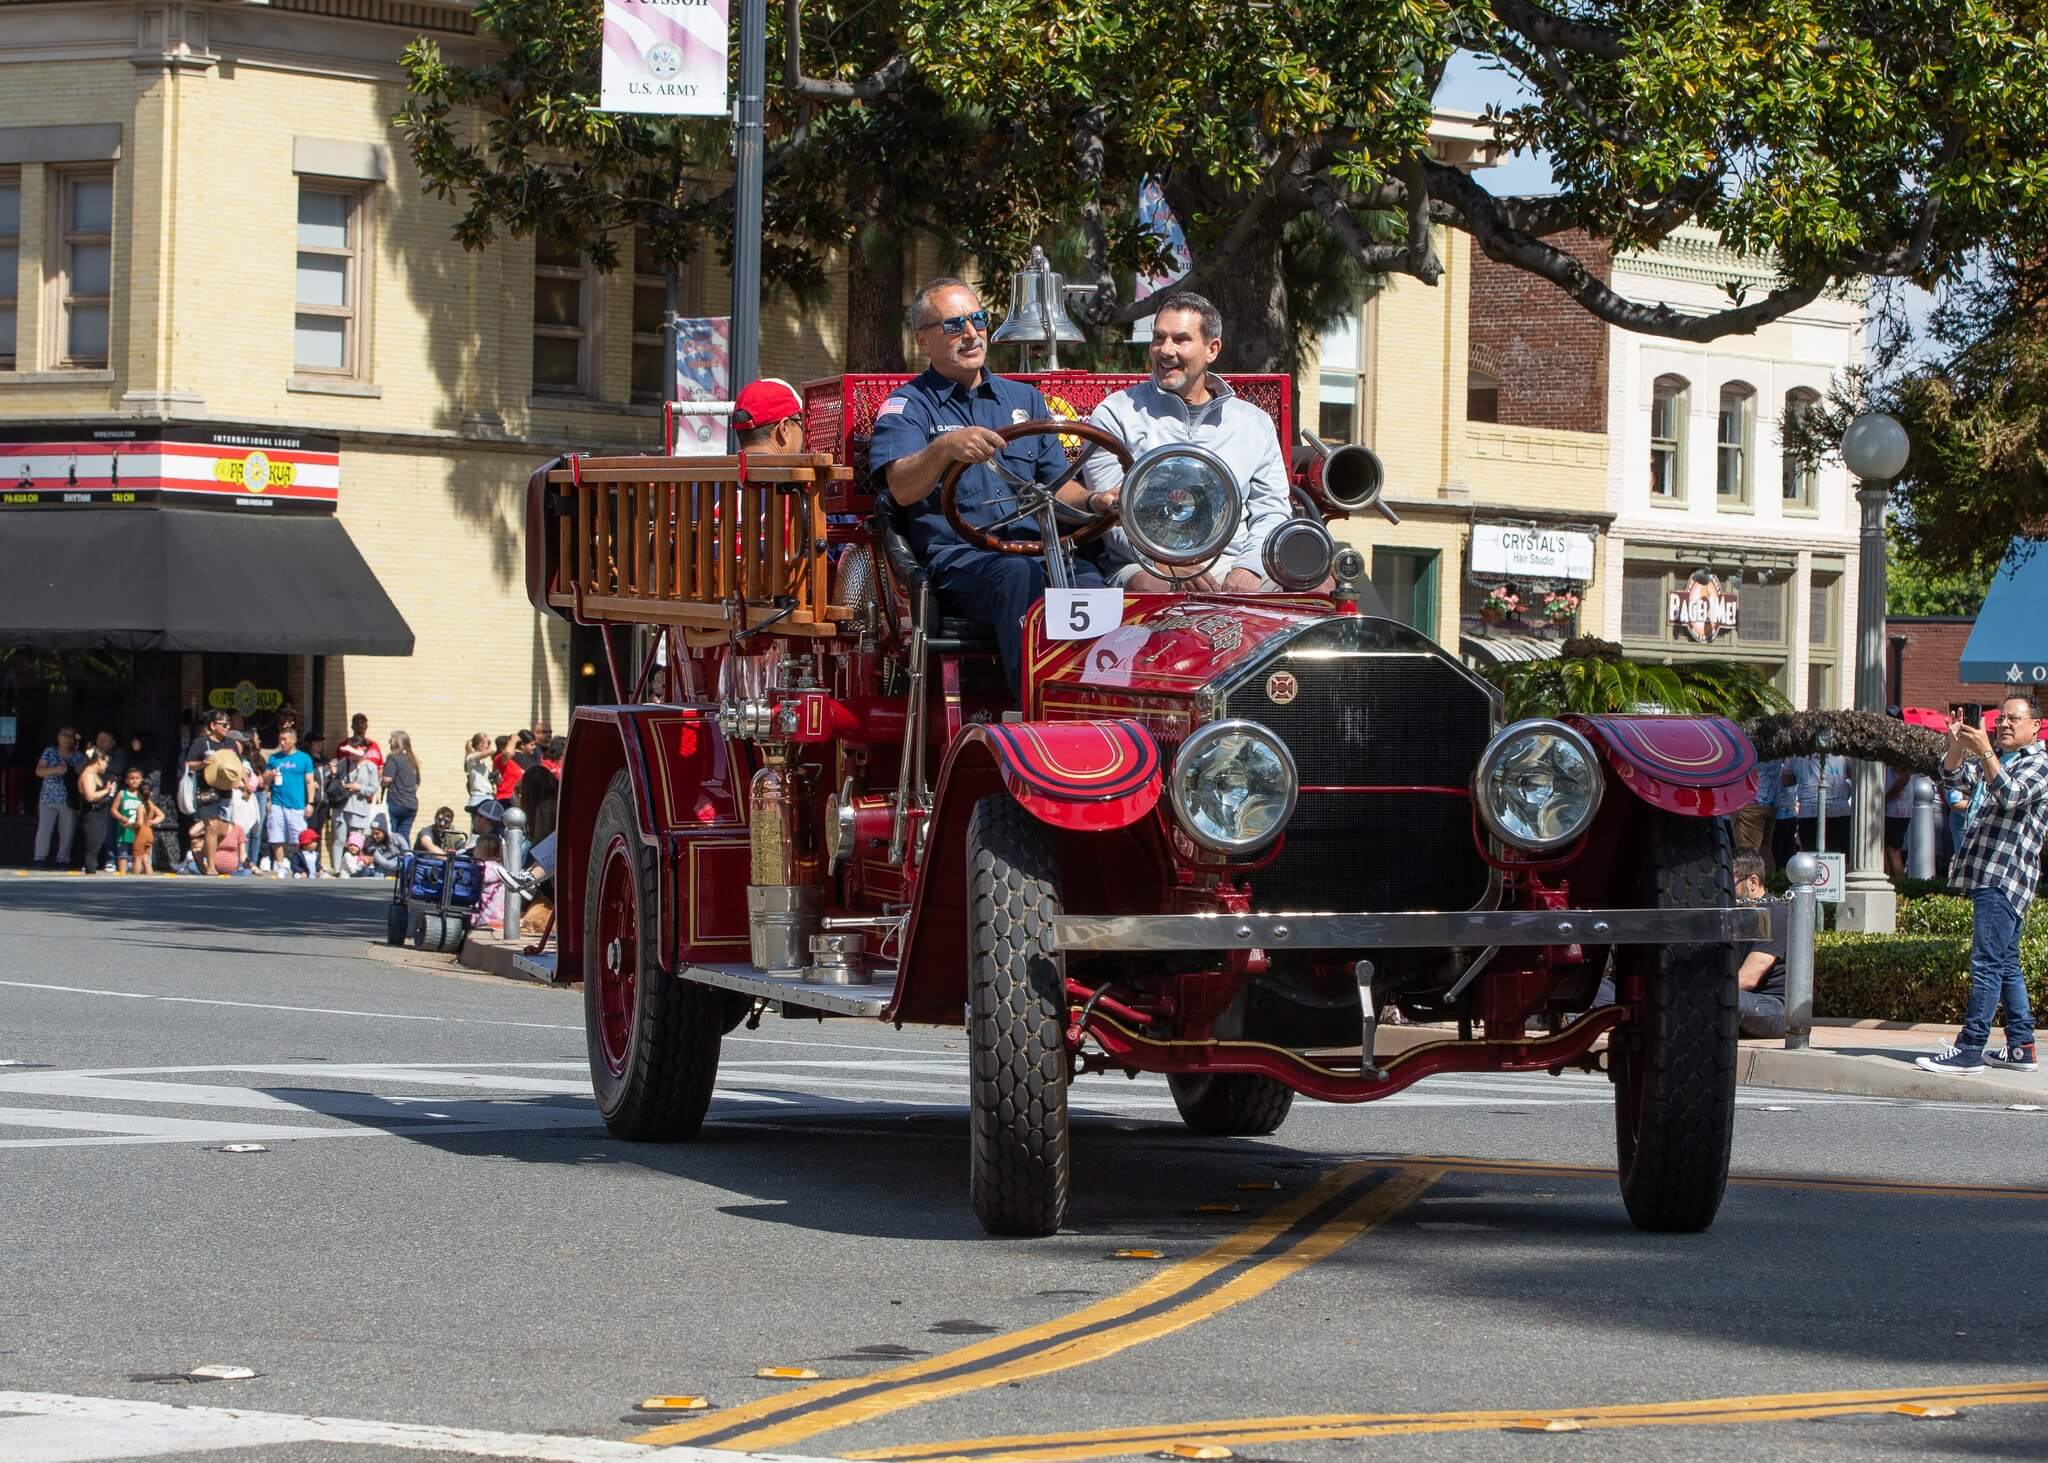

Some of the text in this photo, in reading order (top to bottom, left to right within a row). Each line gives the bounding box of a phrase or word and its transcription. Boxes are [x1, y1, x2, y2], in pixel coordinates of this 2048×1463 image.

[629, 82, 699, 96] U.S. ARMY
[213, 434, 300, 448] INTERNATIONAL LEAGUE
[230, 463, 291, 486] PA KUA
[1502, 533, 1565, 553] CRYSTAL'S
[1513, 553, 1554, 566] Hair Studio
[1069, 601, 1090, 632] 5
